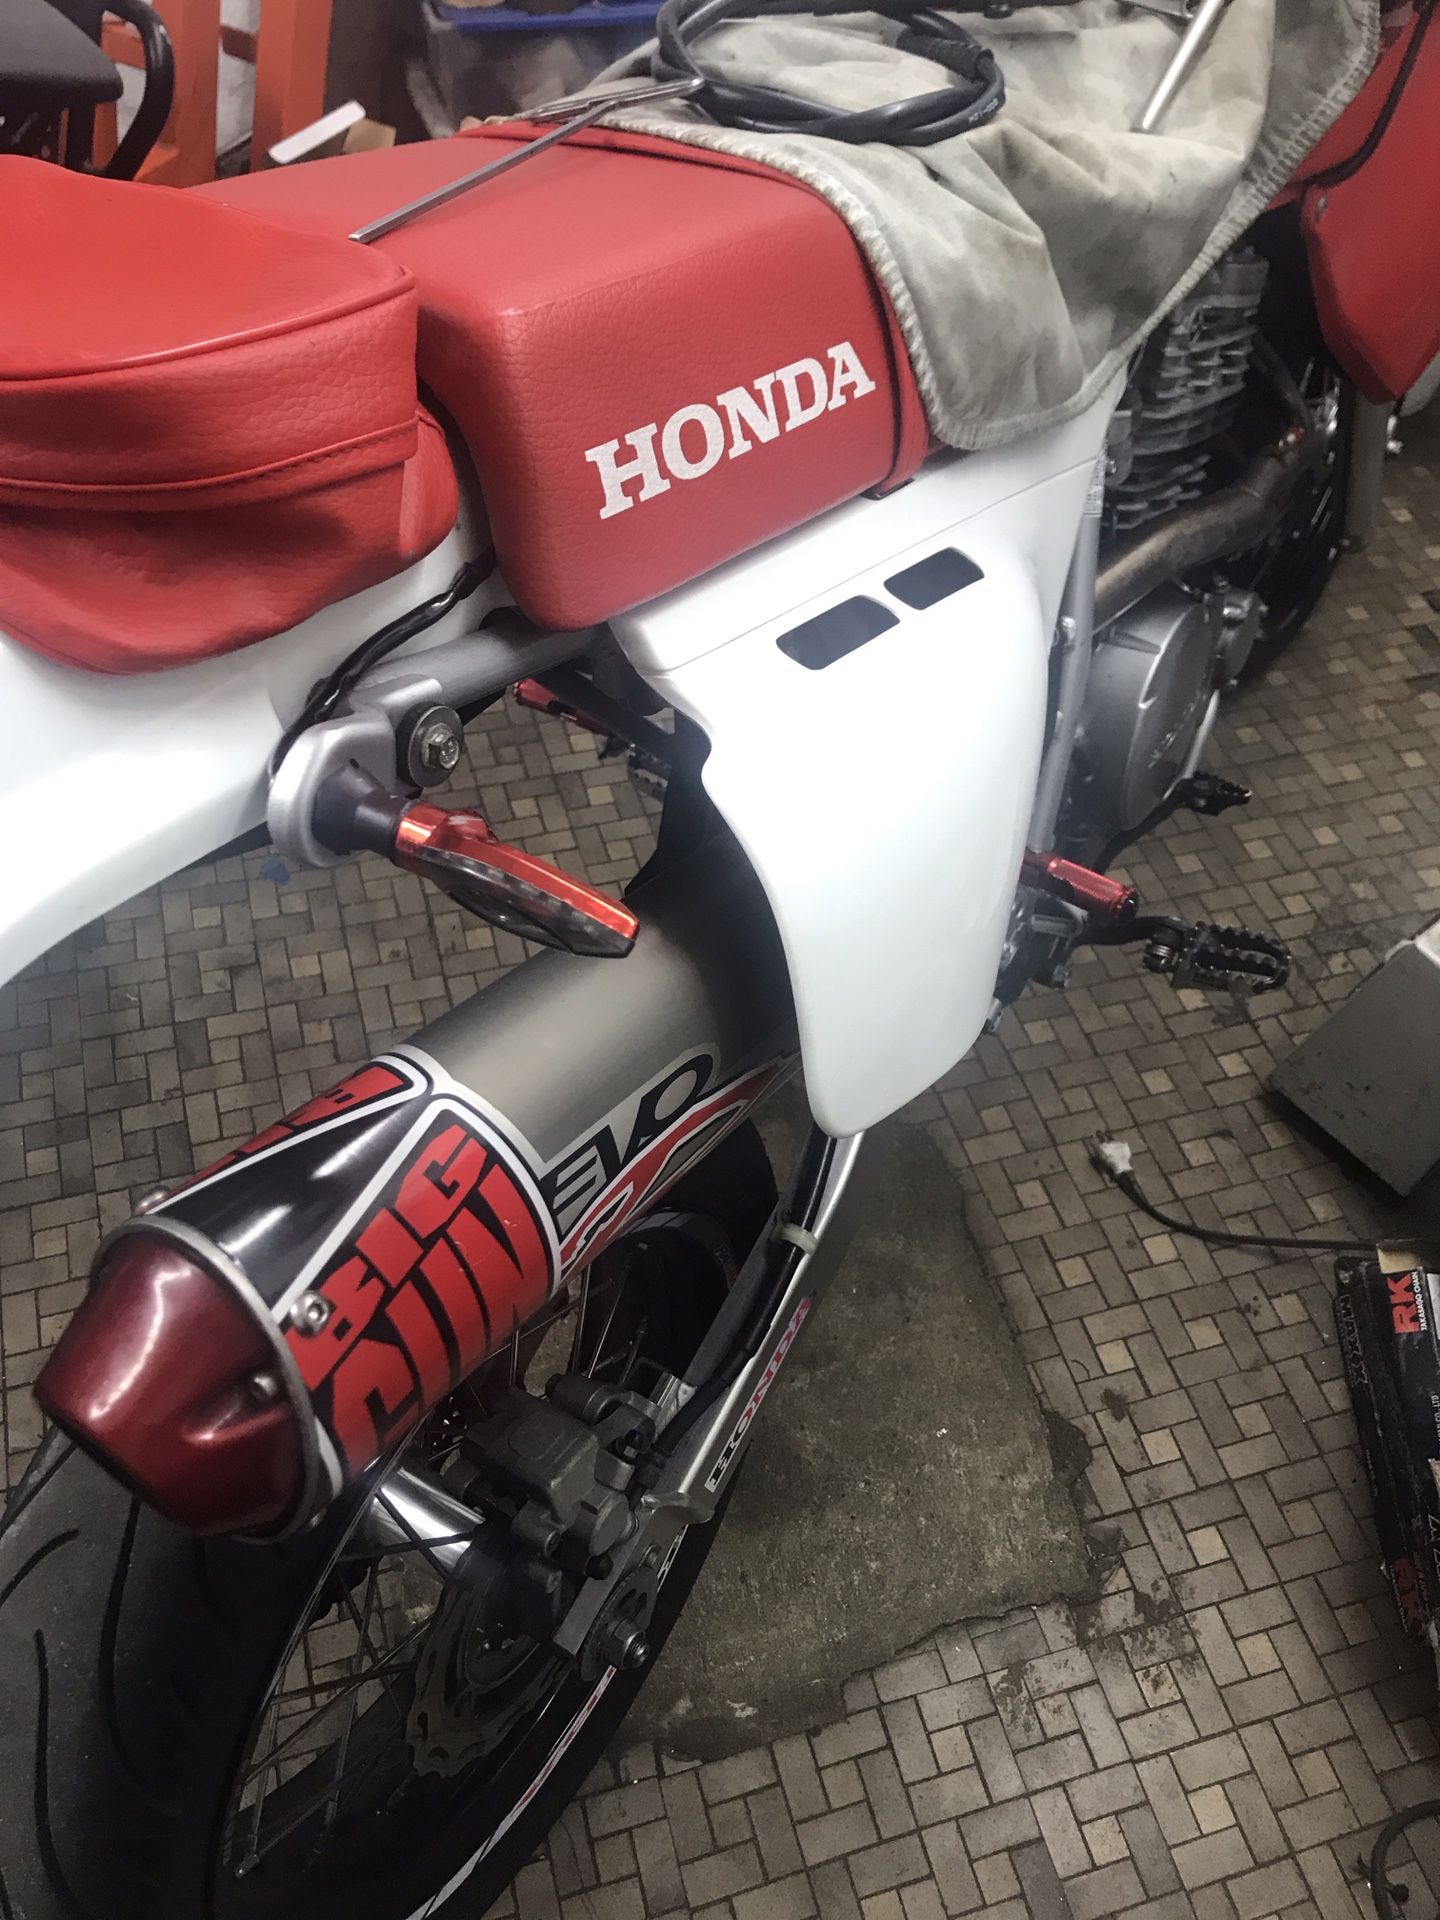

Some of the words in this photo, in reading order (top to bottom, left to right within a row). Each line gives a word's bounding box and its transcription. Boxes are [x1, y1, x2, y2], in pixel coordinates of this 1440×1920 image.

[585, 342, 876, 519] HONDA
[539, 1053, 714, 1240] EVO
[284, 1124, 488, 1392] BIG
[332, 1163, 550, 1476] GUN
[1387, 1273, 1420, 1333] RK
[1411, 1271, 1421, 1293] CHAIN
[1415, 1293, 1427, 1331] TAKASAGO
[709, 1297, 811, 1486] HONDA
